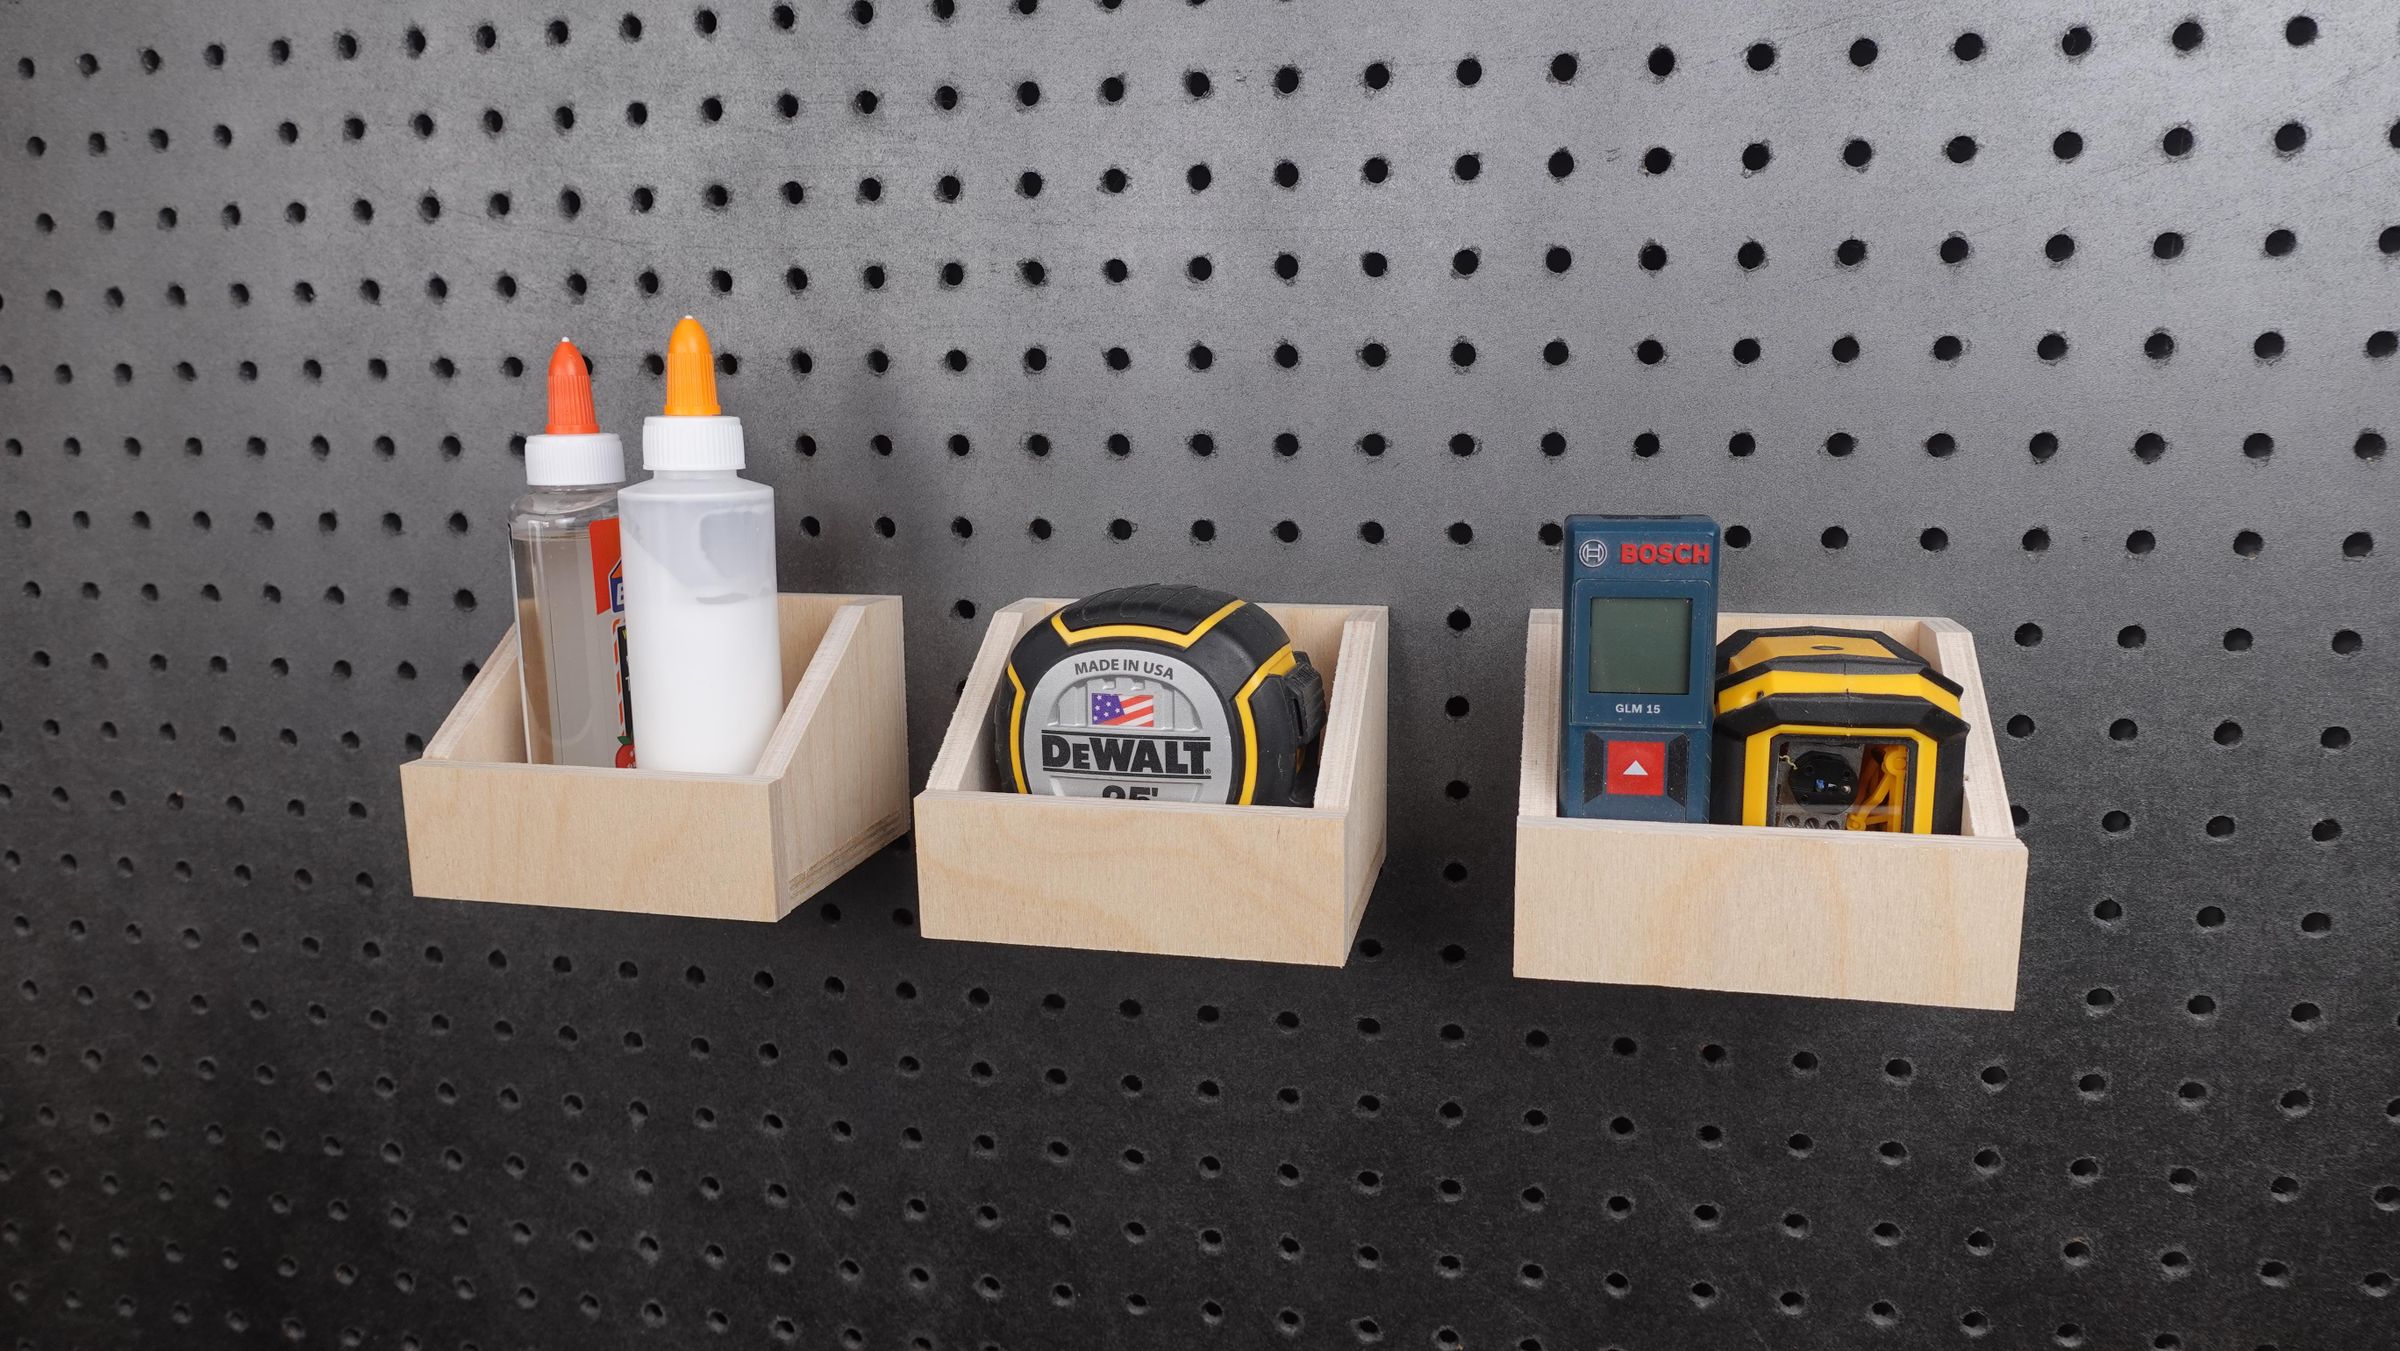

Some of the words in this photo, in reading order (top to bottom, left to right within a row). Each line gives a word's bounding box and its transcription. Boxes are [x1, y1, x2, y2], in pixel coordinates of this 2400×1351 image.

[1620, 543, 1710, 565] BOSCH
[1074, 658, 1119, 675] MADE
[1123, 659, 1139, 672] IN
[1143, 661, 1174, 680] USA
[1615, 703, 1643, 714] GLM
[1646, 704, 1661, 714] 15
